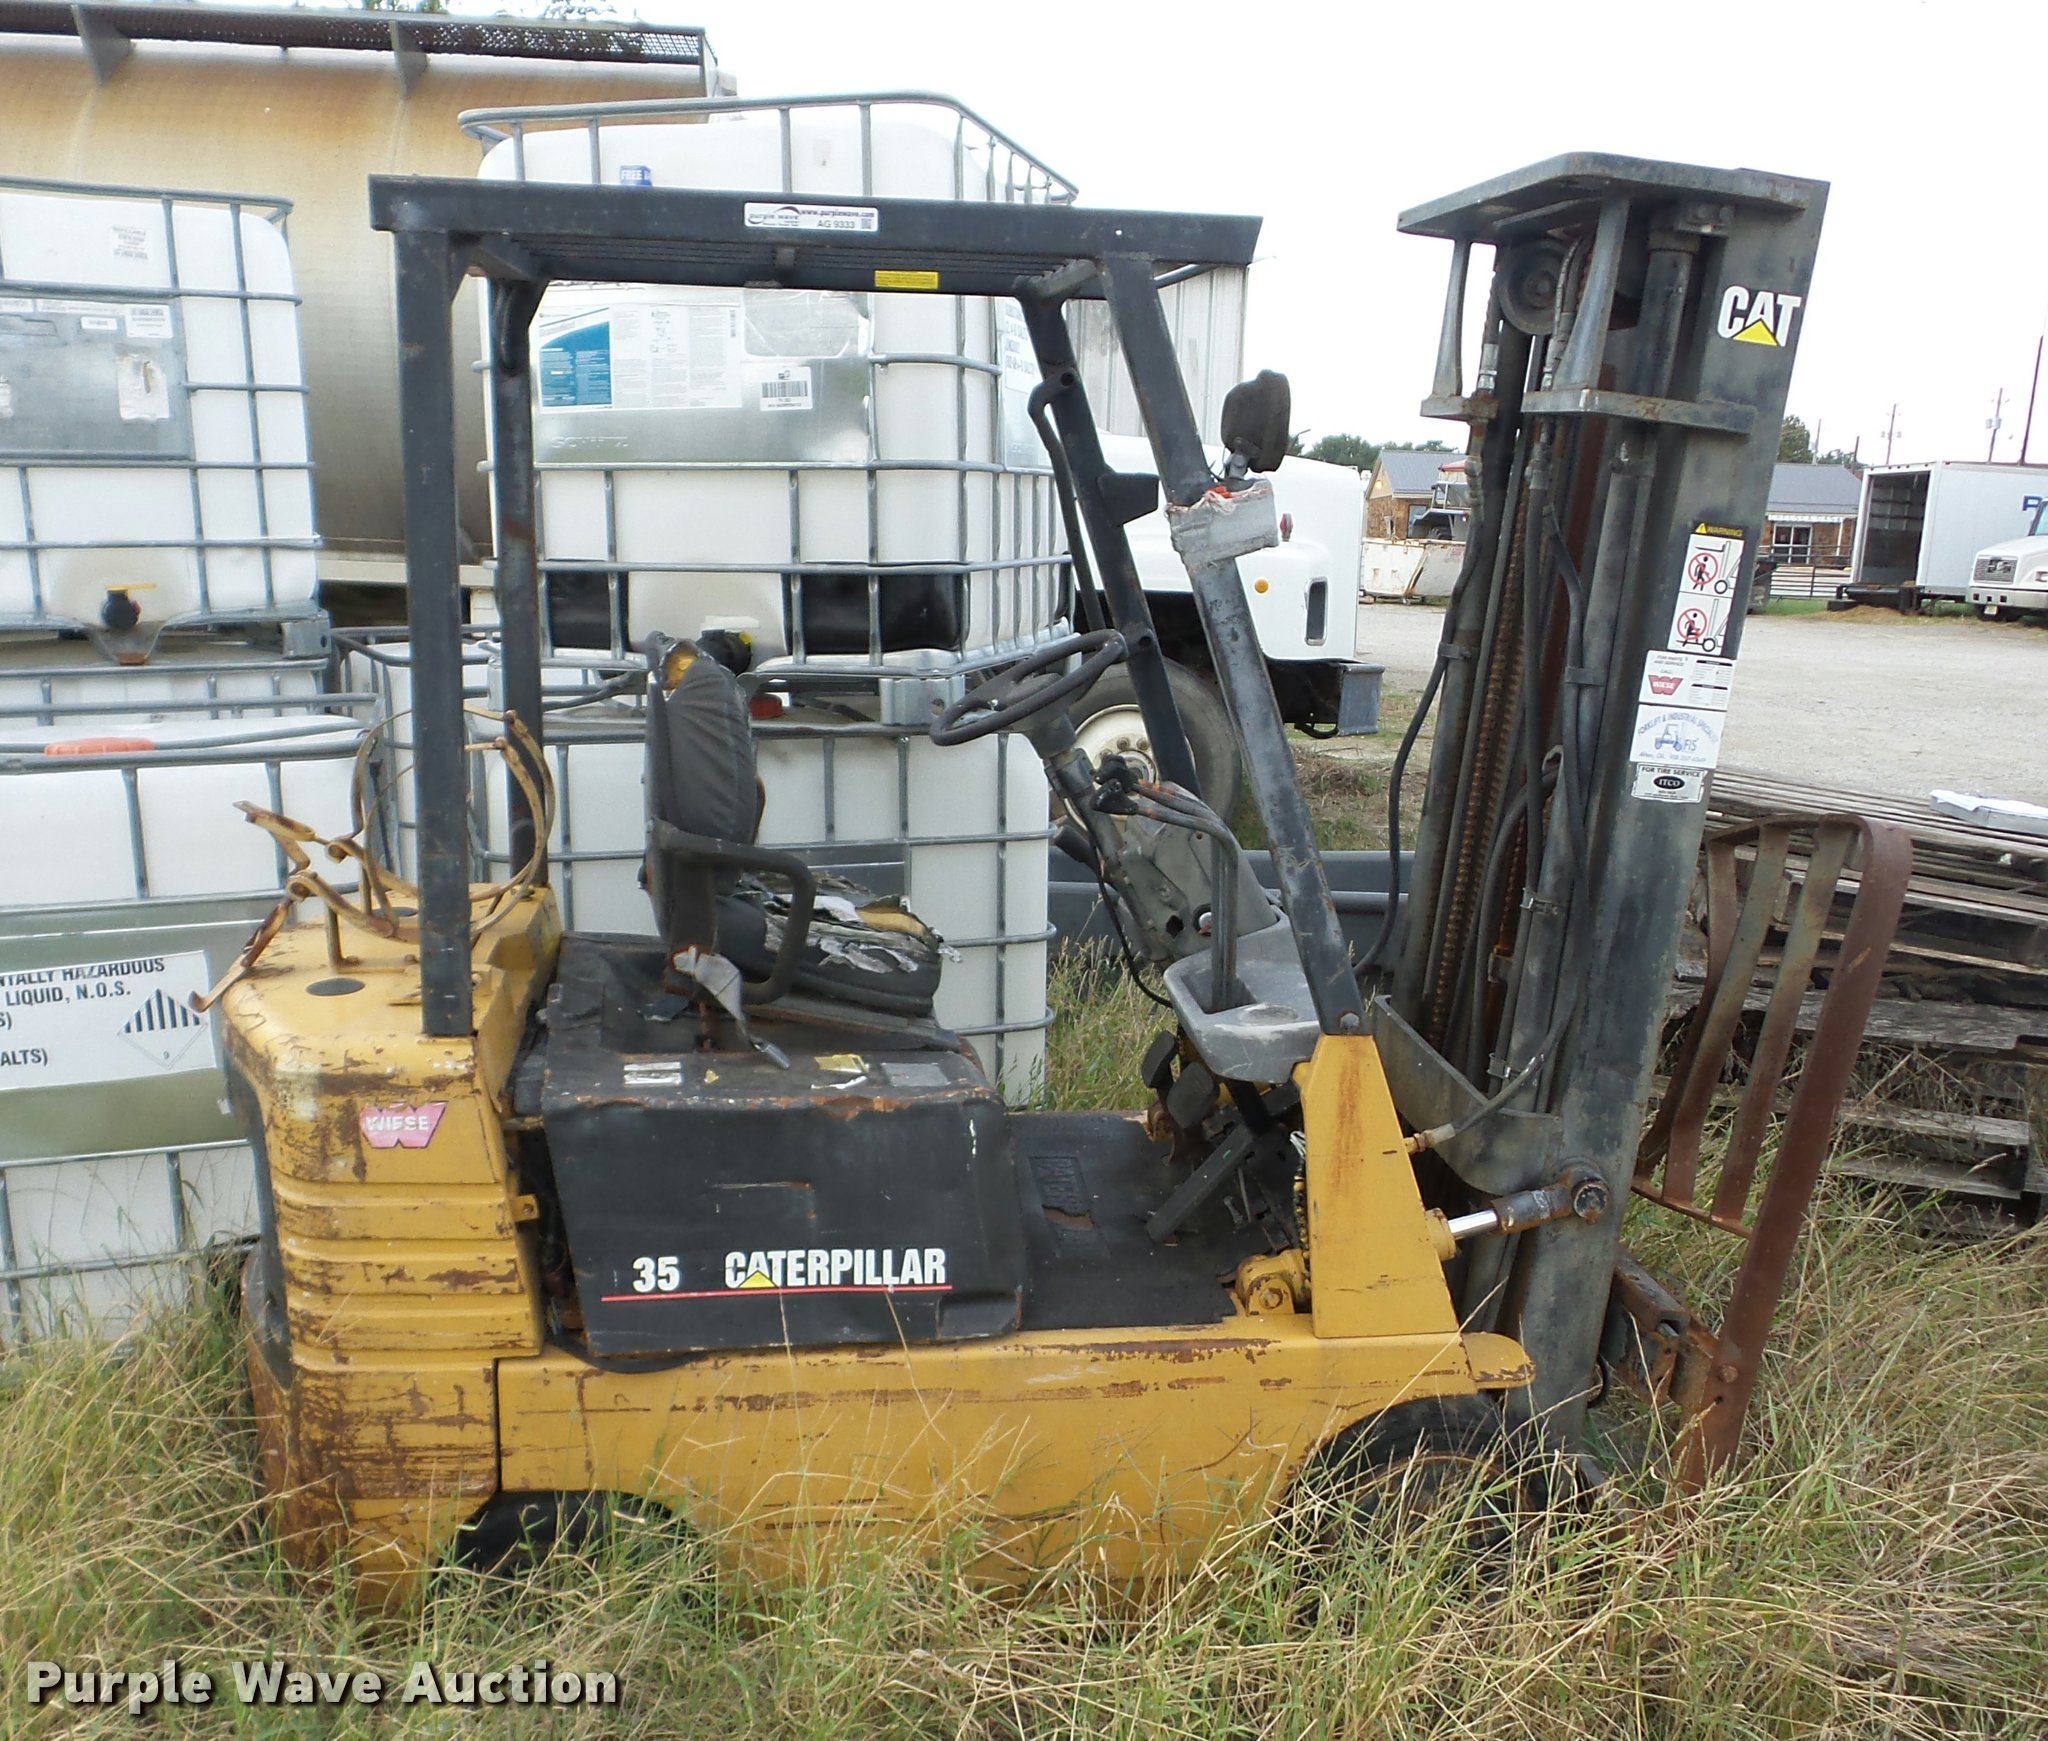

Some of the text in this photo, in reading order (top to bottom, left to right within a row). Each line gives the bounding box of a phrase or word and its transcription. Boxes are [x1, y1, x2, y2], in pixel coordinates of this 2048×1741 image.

[818, 219, 856, 229] AG 9333
[1717, 285, 1803, 347] CAT
[1657, 767, 1671, 775] TIRE
[1673, 769, 1700, 778] SERVICE
[1658, 778, 1681, 787] ITCO
[62, 957, 166, 982] HAZARDOUS
[5, 980, 132, 1006] LIQUID, N.O.S.
[1, 1048, 48, 1067] ALTS)
[365, 1115, 430, 1132] WIESE
[632, 1247, 947, 1293] 35 CATERPILLAR
